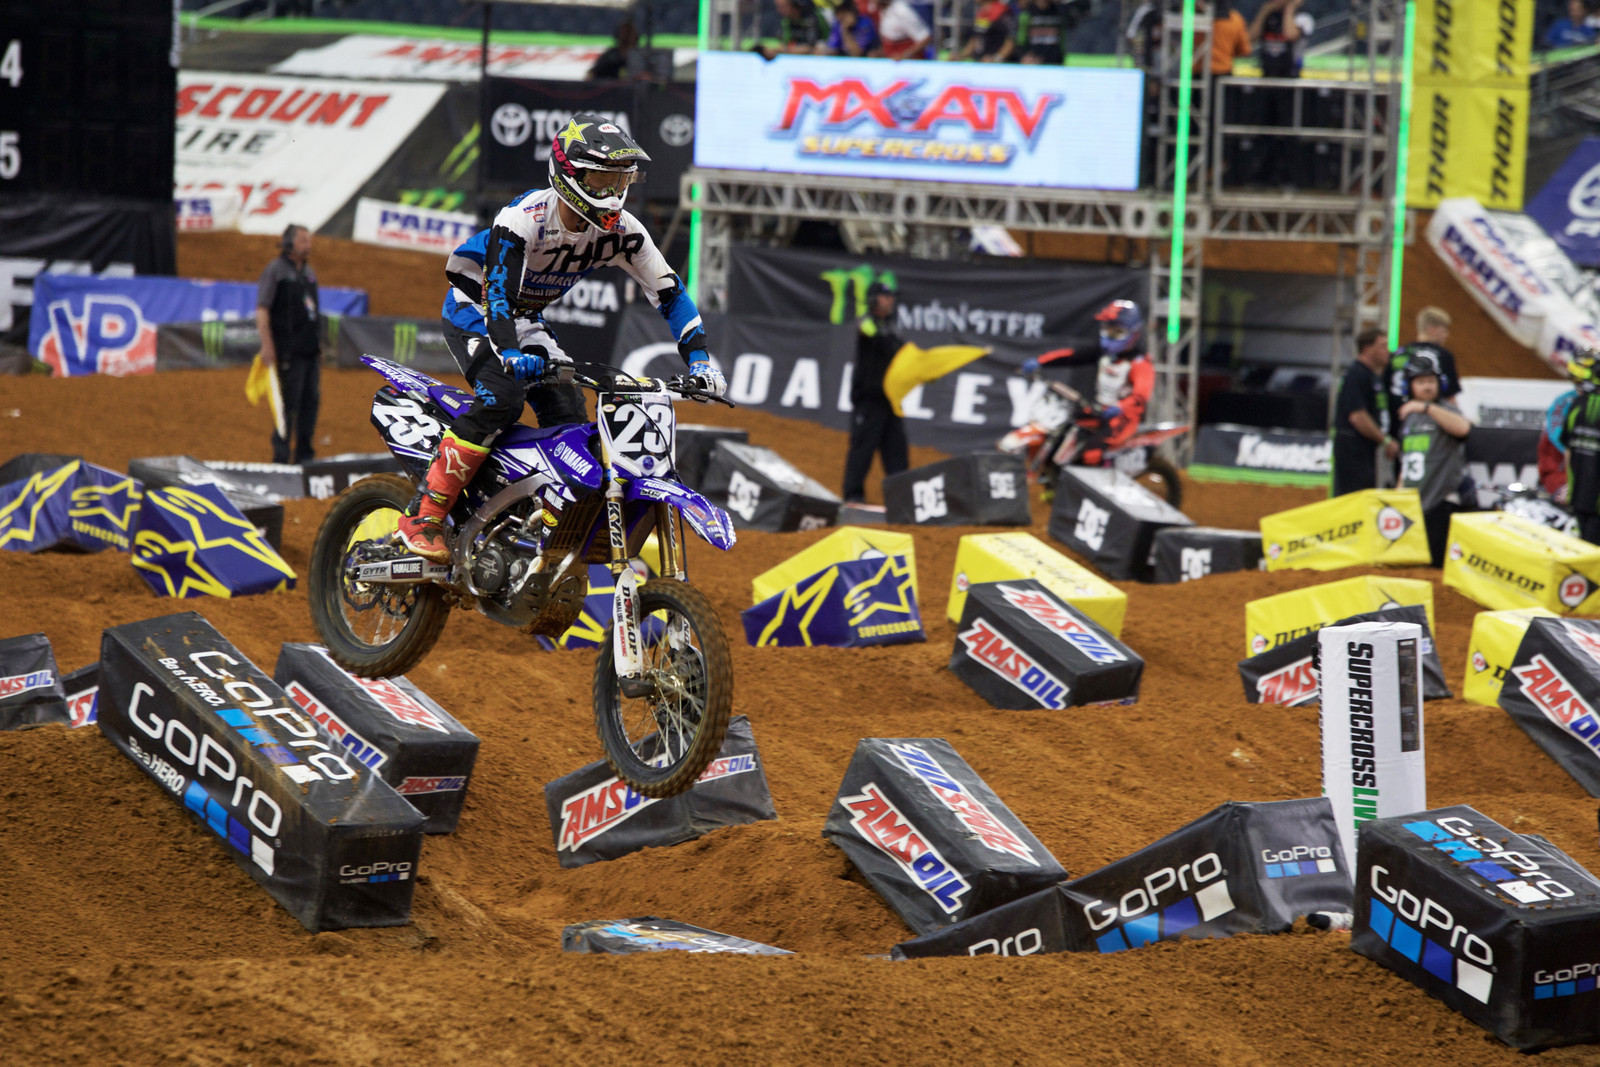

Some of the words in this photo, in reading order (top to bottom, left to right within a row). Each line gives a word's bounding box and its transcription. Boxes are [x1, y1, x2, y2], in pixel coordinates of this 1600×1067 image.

[0, 39, 23, 87] 4
[1429, 0, 1453, 78] THO
[1495, 0, 1516, 77] THO
[176, 84, 391, 128] SCOUNT
[0, 131, 22, 179] 5
[802, 134, 1012, 165] SUPERCROSS
[1426, 94, 1450, 199] THOR
[1490, 98, 1515, 201] THOR
[542, 232, 645, 275] THOR
[371, 397, 442, 446] 23
[612, 402, 673, 454] 23
[560, 445, 594, 478] YAMAHA
[608, 500, 625, 549] KYB
[392, 562, 422, 574] YAMALUBE
[1466, 553, 1546, 594] DUNLOP
[621, 584, 638, 657] DUNLOP
[0, 670, 53, 696] MSOIL
[960, 618, 1070, 709] AMSOIL
[1255, 657, 1320, 705] AMS
[285, 681, 390, 775] AMSOIL
[1516, 655, 1600, 758] AMSO
[128, 682, 283, 838] GoPro
[396, 776, 467, 796] AMSOIL
[339, 861, 412, 876] GoPro
[840, 782, 972, 915] AMSOIL
[1261, 845, 1332, 863] GoPro
[1436, 816, 1576, 899] GoPro
[1083, 851, 1224, 931] GoPro
[1370, 865, 1494, 967] GoPro
[968, 928, 1042, 957] Pro
[1534, 963, 1600, 985] GoPr
